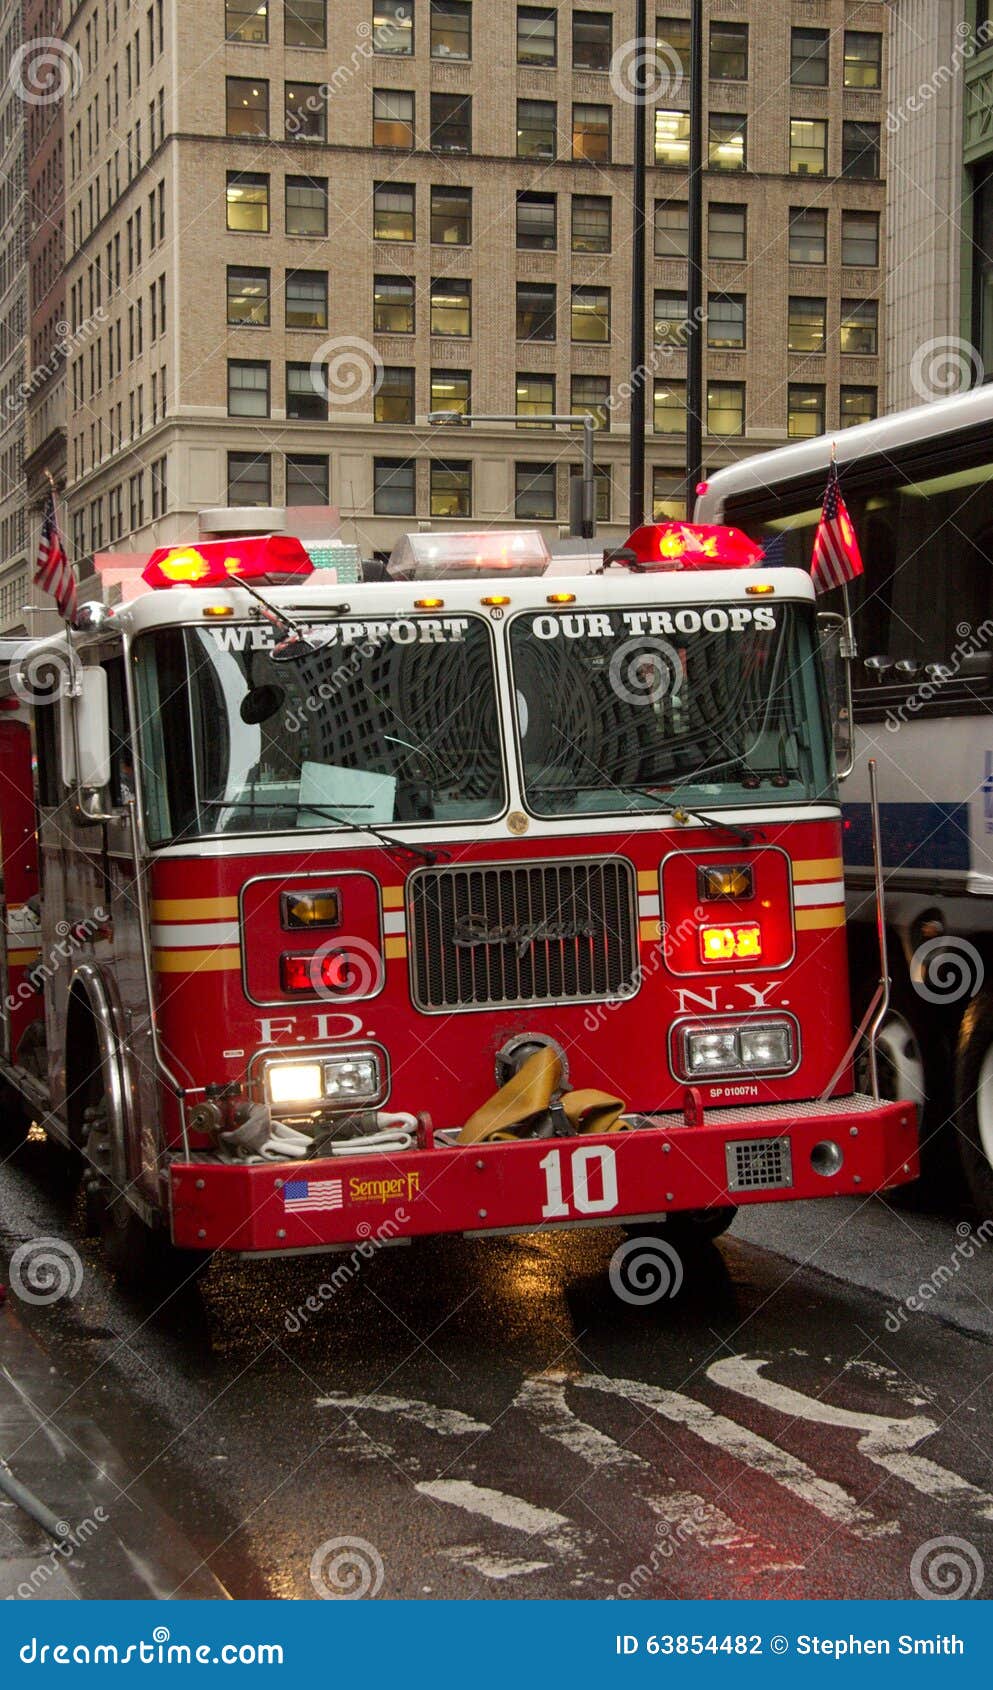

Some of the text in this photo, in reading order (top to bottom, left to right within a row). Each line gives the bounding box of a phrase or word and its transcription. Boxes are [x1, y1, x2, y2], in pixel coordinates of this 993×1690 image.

[209, 619, 468, 651] WE PPORT
[532, 607, 776, 639] OUR TROOPS
[673, 981, 790, 1013] N.Y.
[254, 1013, 376, 1044] F.D.
[710, 1086, 758, 1097] SP 01007H
[349, 1172, 419, 1204] Semper Fi
[539, 1144, 619, 1218] 10
